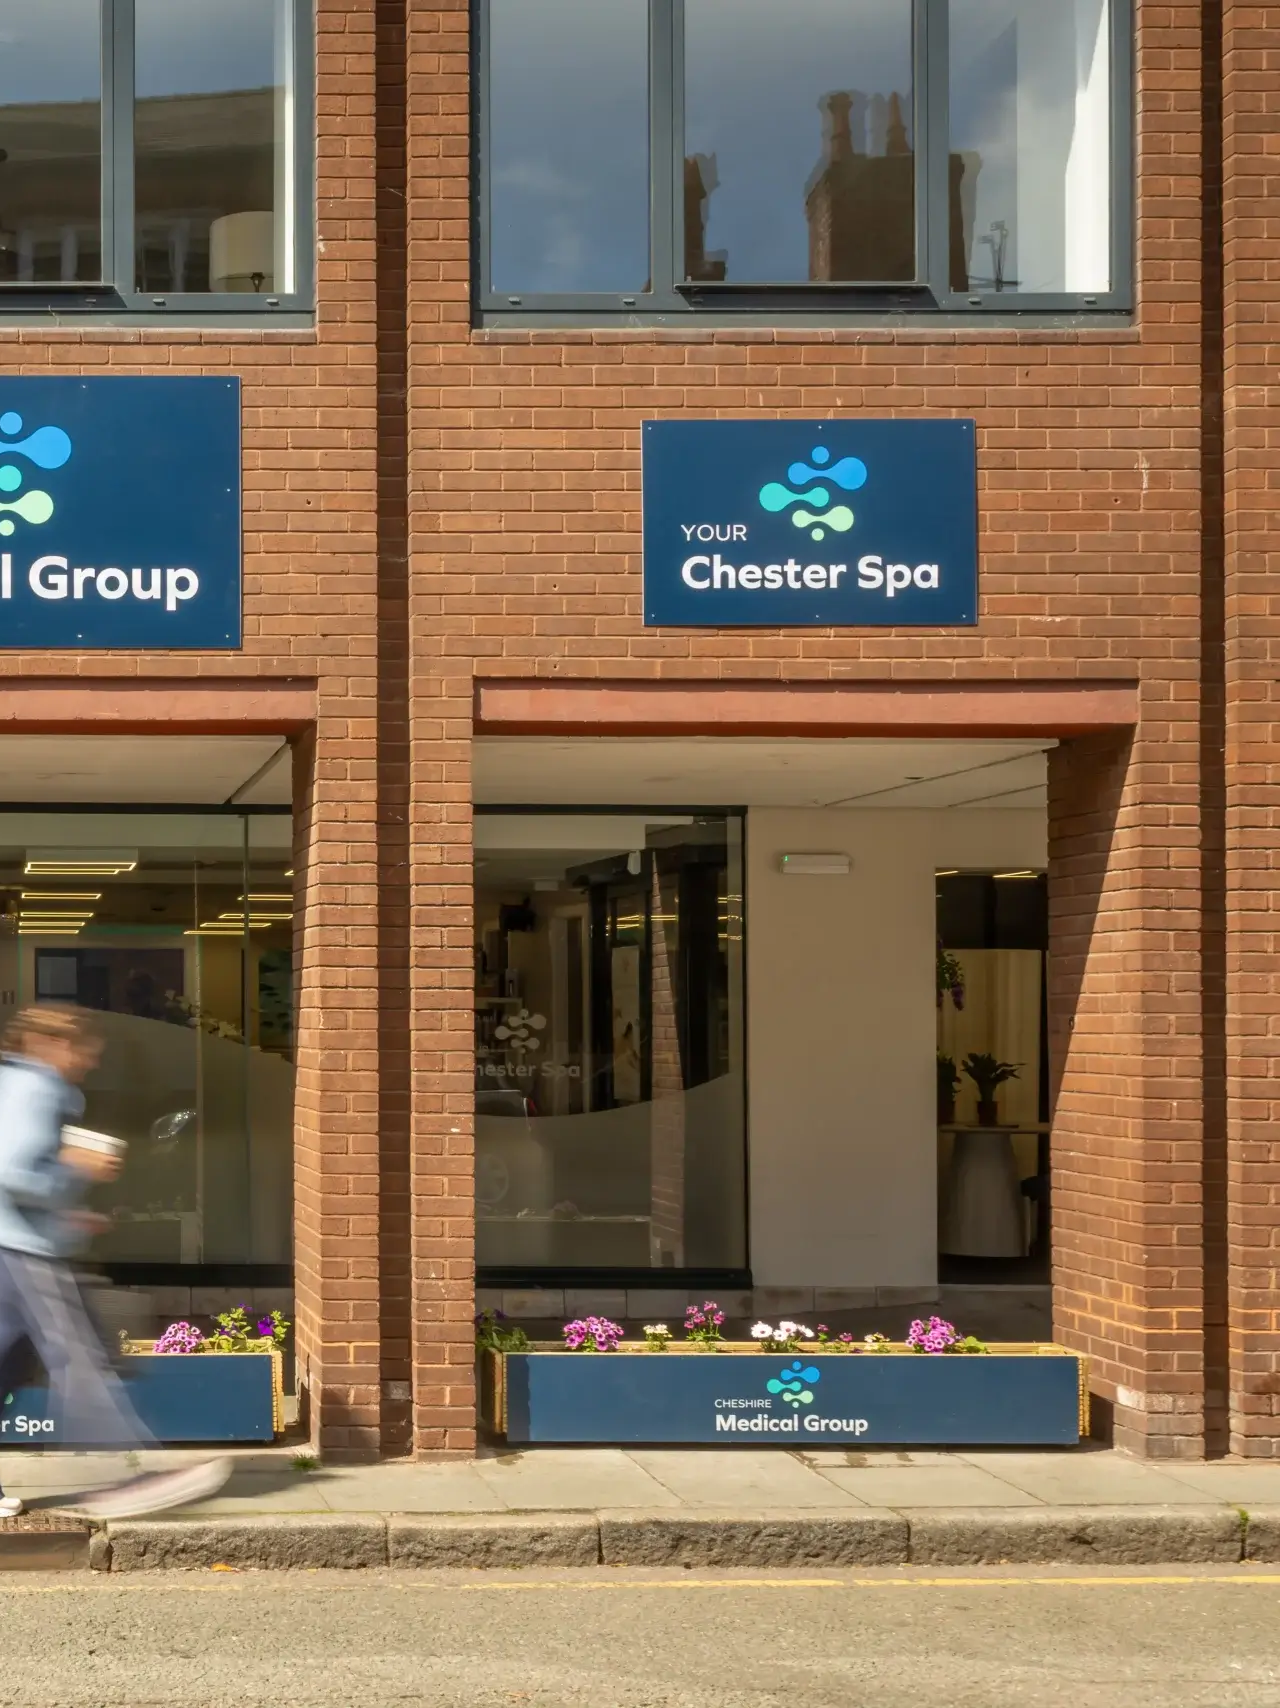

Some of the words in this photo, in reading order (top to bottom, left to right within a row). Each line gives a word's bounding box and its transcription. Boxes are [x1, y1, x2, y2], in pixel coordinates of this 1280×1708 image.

[680, 524, 747, 541] YOUR
[28, 555, 199, 611] Group
[681, 554, 847, 589] Chester
[857, 555, 939, 597] Spa
[476, 1062, 536, 1077] ester
[714, 1398, 772, 1409] CHESHIRE
[14, 1415, 55, 1436] Spa
[715, 1414, 798, 1432] Medical
[803, 1414, 869, 1436] Group
